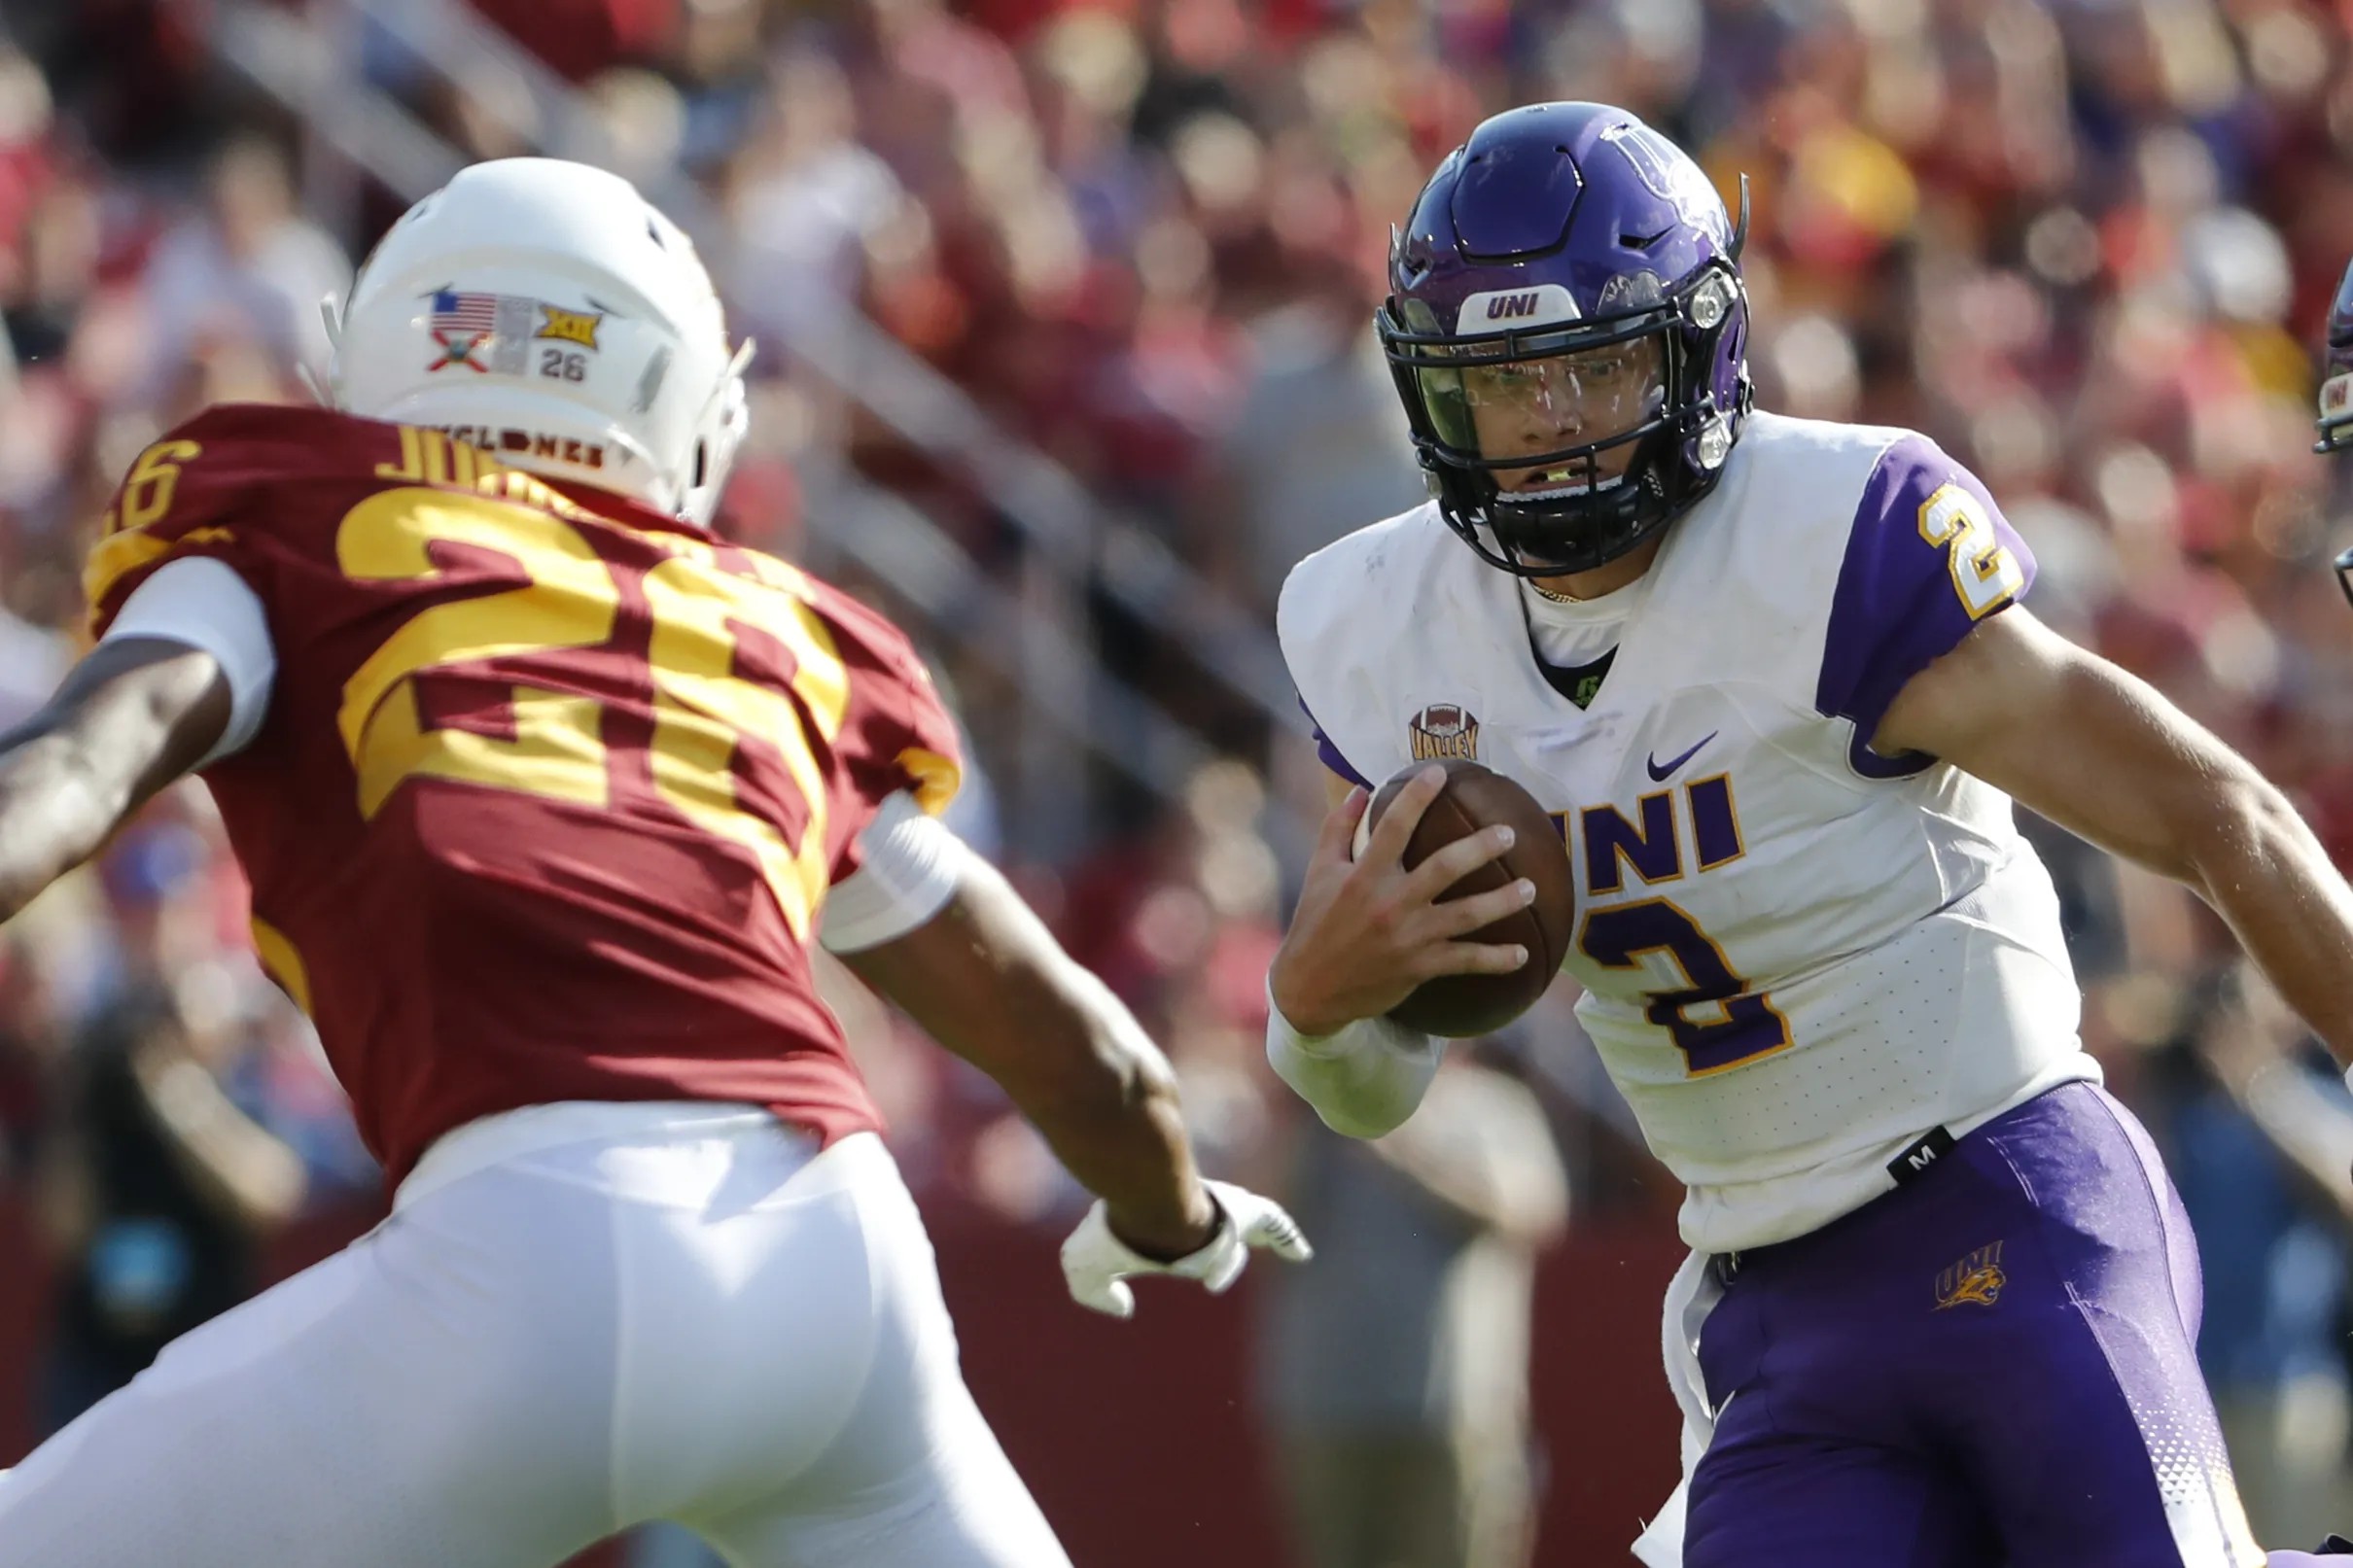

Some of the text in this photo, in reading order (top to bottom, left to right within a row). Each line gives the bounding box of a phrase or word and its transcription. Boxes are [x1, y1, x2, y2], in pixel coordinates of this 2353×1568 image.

[1487, 294, 1539, 319] UNI
[540, 348, 586, 382] 26
[1917, 483, 2024, 621] 2
[335, 486, 849, 943] 26
[1408, 722, 1479, 760] VALLEY
[1548, 772, 1746, 896] NI
[1576, 894, 1795, 1079] 2
[1908, 1144, 1936, 1170] M
